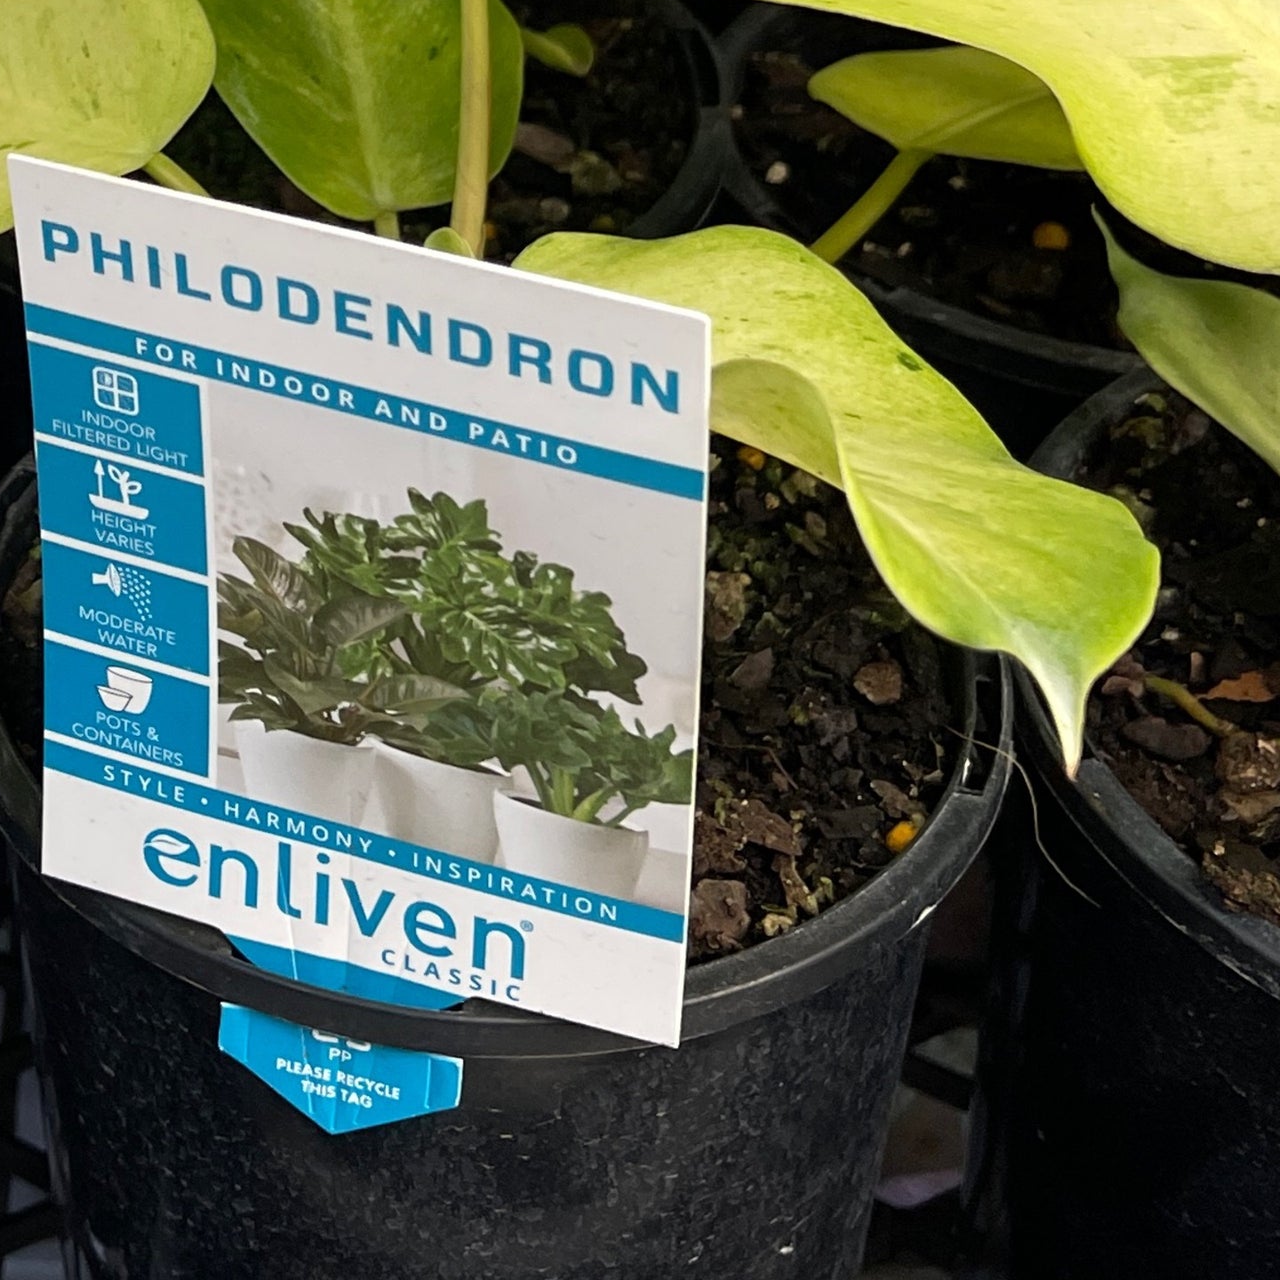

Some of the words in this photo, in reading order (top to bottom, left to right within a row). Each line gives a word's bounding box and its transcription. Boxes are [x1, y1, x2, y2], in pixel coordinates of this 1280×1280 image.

[40, 219, 680, 414] PHILODENDRON
[135, 337, 198, 370] FOR
[216, 358, 355, 409] INDOOR
[375, 399, 448, 432] AND
[469, 422, 578, 465] PATIO
[52, 418, 131, 452] FILTERED
[136, 439, 189, 468] LIGHT
[81, 409, 156, 442] INDOOR
[91, 509, 157, 539] HEIGHT
[95, 527, 155, 556] VARIES
[79, 605, 176, 645] MODERATE
[97, 628, 158, 657] WATER
[72, 722, 183, 767] CONTAINERS
[96, 711, 141, 737] POTS
[147, 726, 160, 742] &
[102, 764, 186, 804] STYLE
[224, 799, 373, 854] HARMONY
[412, 851, 618, 921] INSPIRATION
[381, 948, 522, 1002] CLASSIC
[328, 1047, 352, 1062] PP
[276, 1057, 332, 1081] PLEASE
[336, 1072, 401, 1101] RECYCLE
[301, 1079, 337, 1099] THIS
[340, 1089, 373, 1110] TAG
